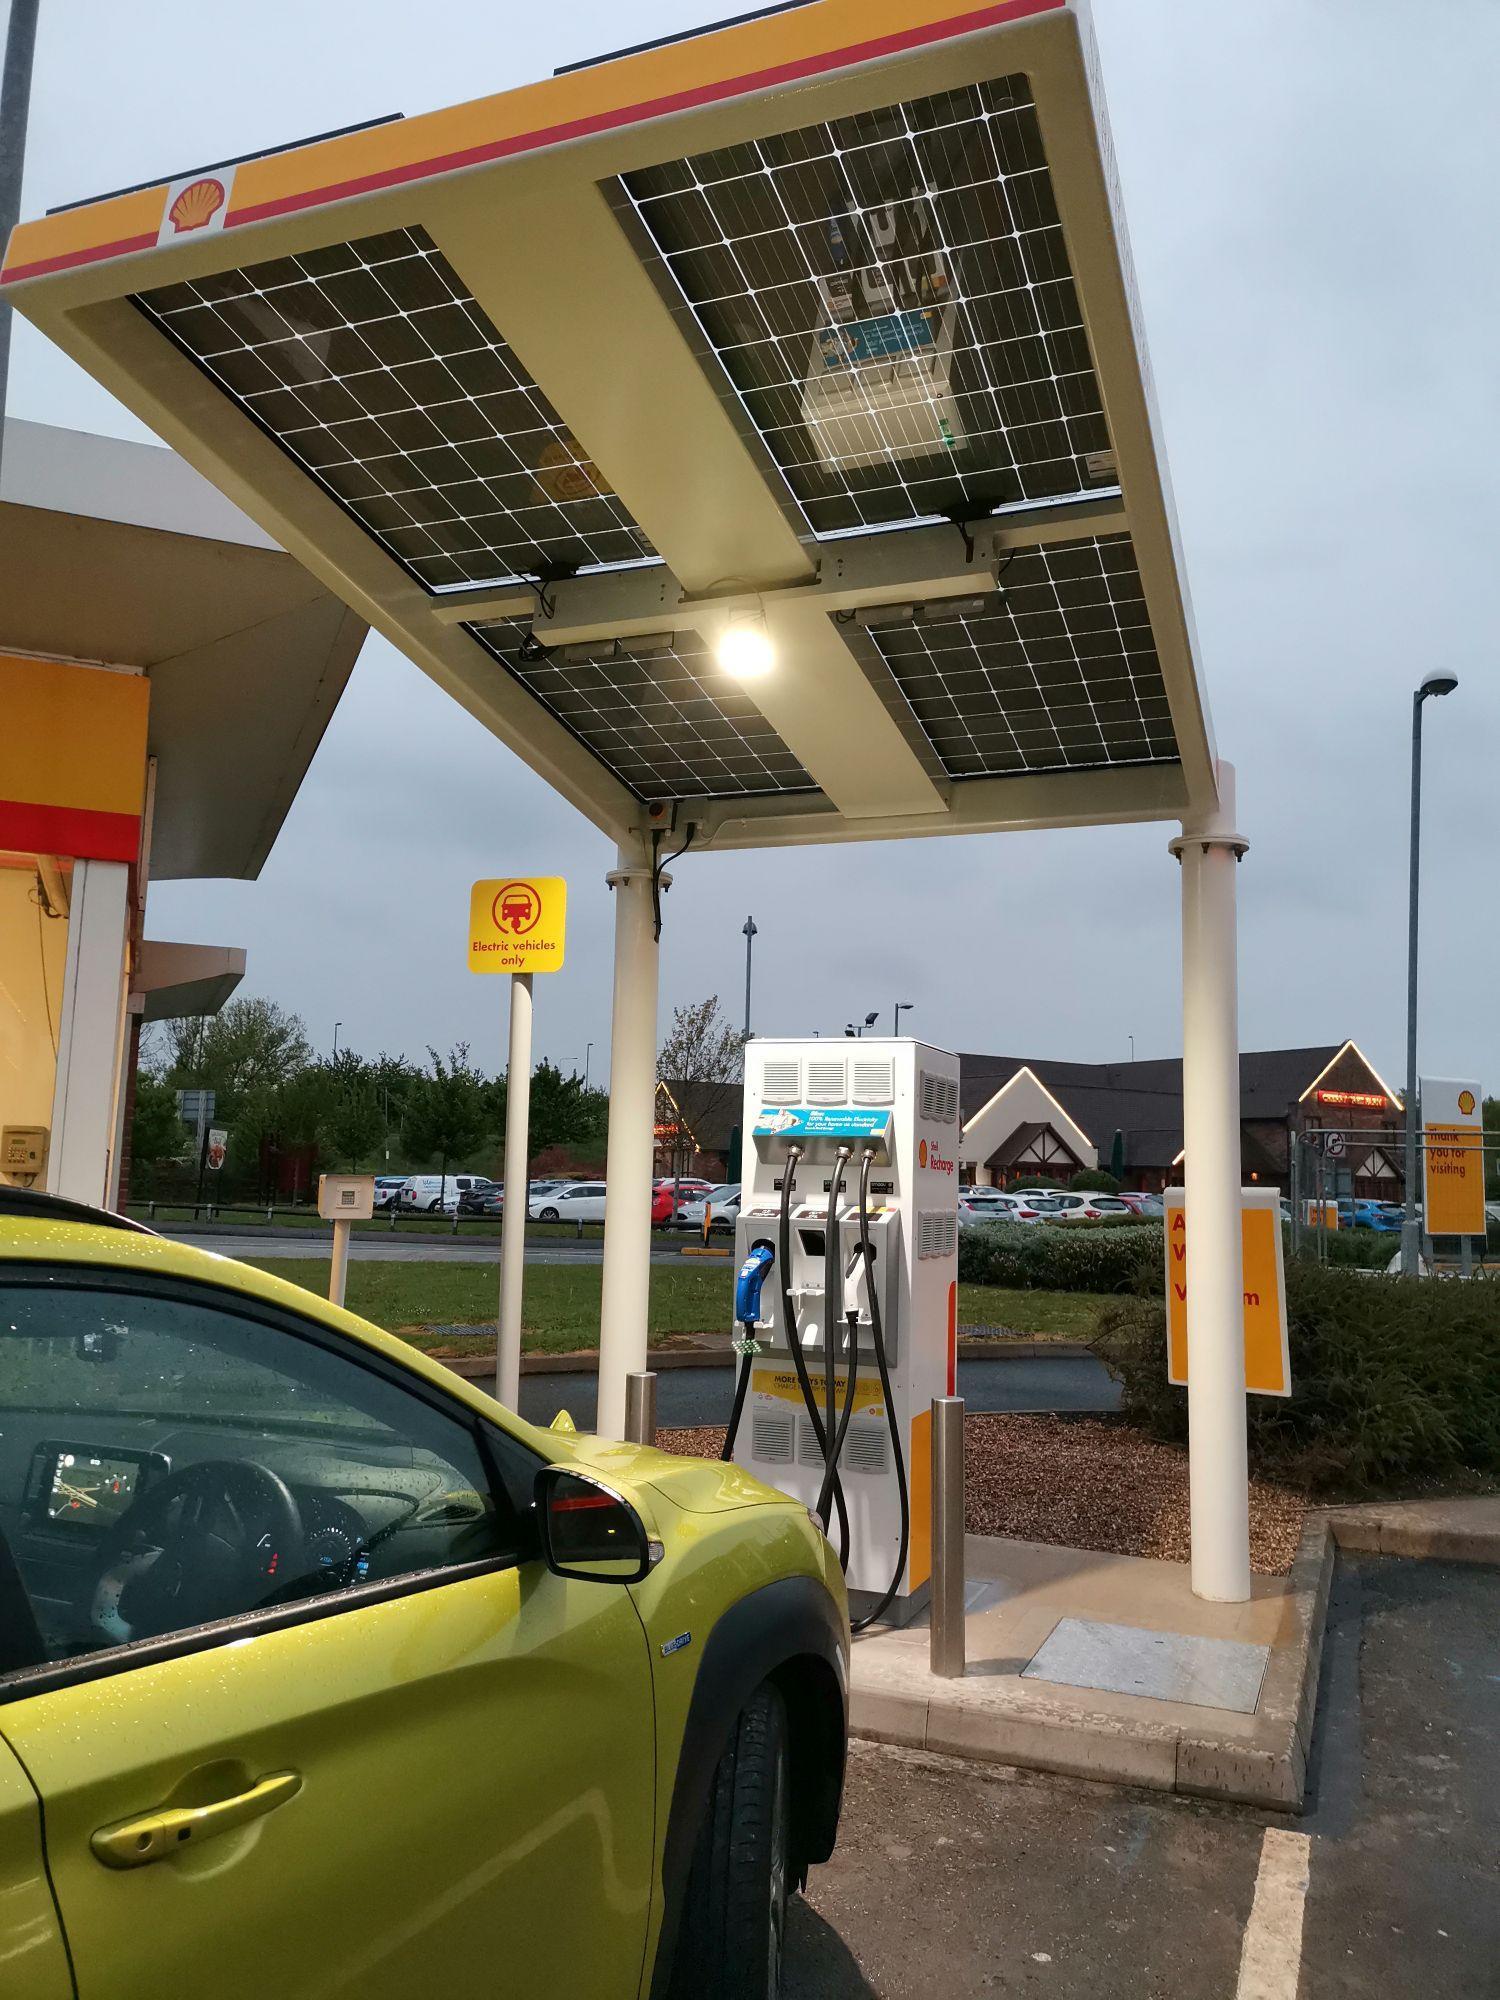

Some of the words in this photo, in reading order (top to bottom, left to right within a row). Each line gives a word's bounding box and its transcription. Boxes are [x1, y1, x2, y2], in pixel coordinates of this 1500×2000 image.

[473, 941, 509, 951] Electric
[513, 939, 555, 950] vehicles
[501, 954, 525, 967] only
[1429, 1128, 1459, 1141] Thank
[931, 1141, 939, 1151] Shell
[1430, 1148, 1449, 1160] you
[1451, 1146, 1466, 1158] for
[931, 1154, 954, 1175] Recharge
[1430, 1161, 1466, 1178] visiting
[774, 1375, 796, 1384] MORE
